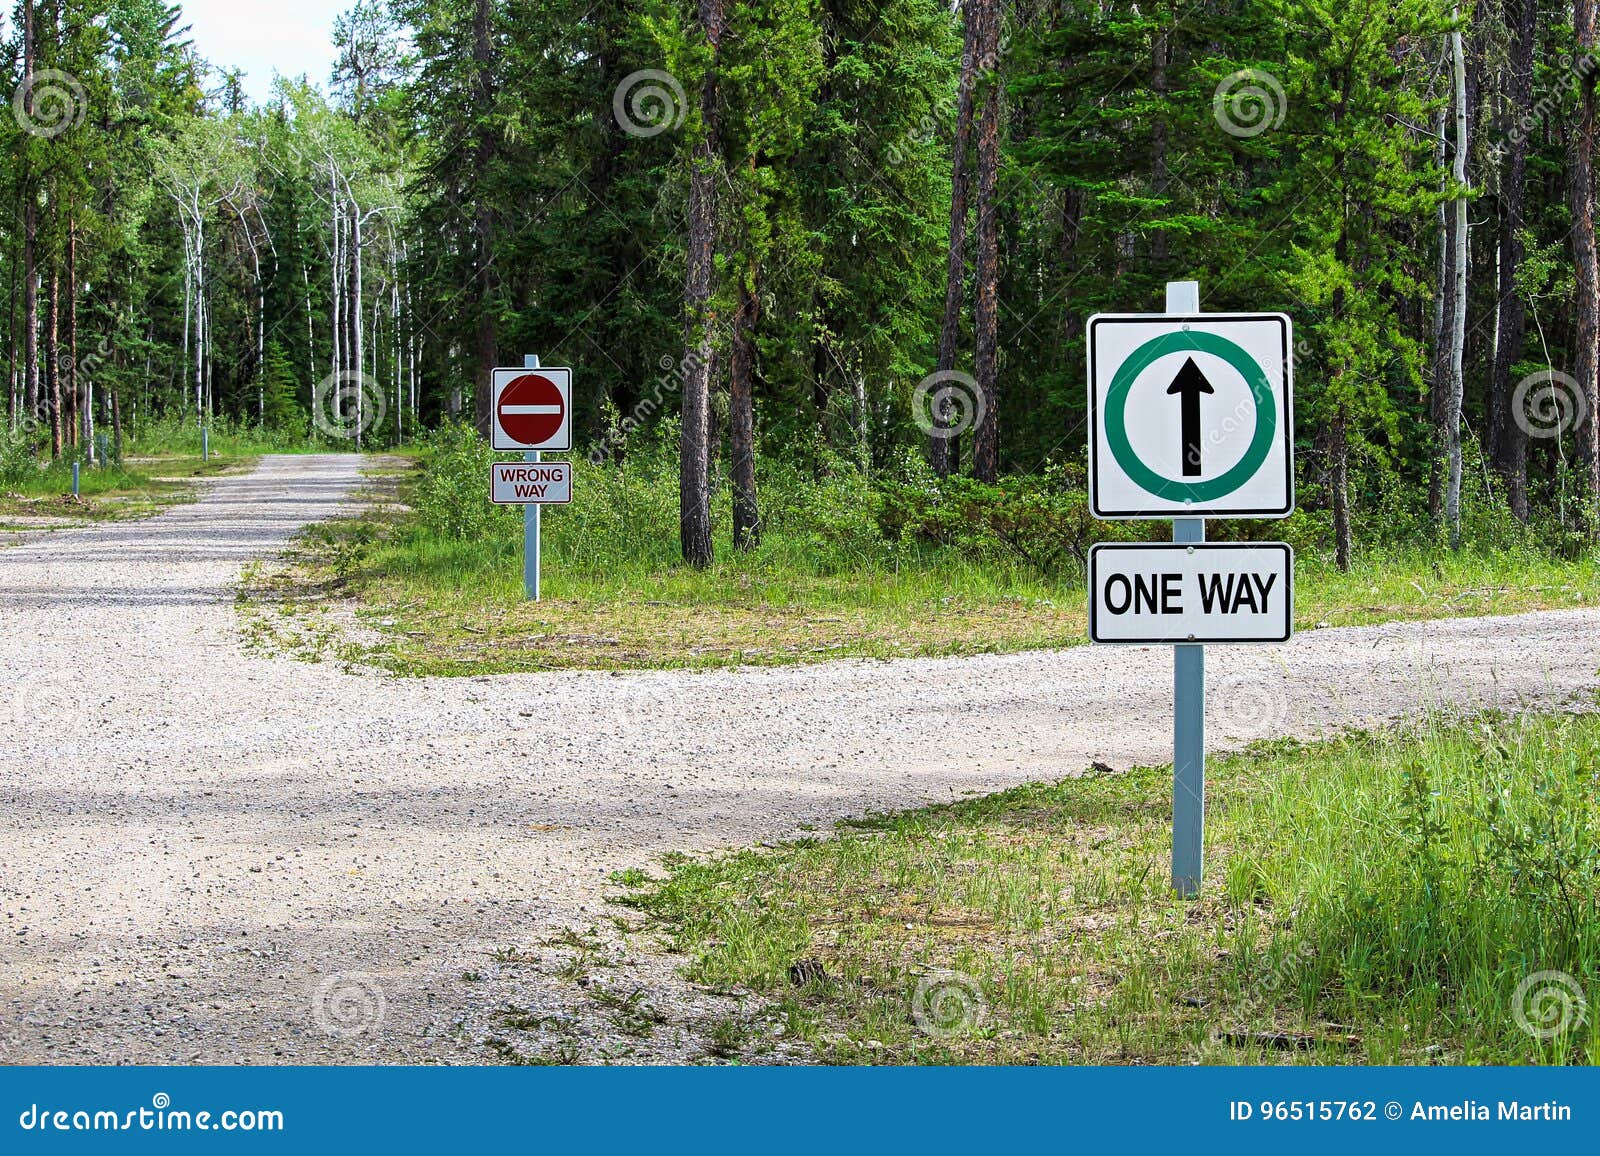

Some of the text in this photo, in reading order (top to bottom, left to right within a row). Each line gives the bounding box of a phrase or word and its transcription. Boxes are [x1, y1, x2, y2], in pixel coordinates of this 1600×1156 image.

[500, 468, 563, 482] WRONG
[515, 484, 548, 498] WAY
[1104, 572, 1278, 615] ONE WAY
